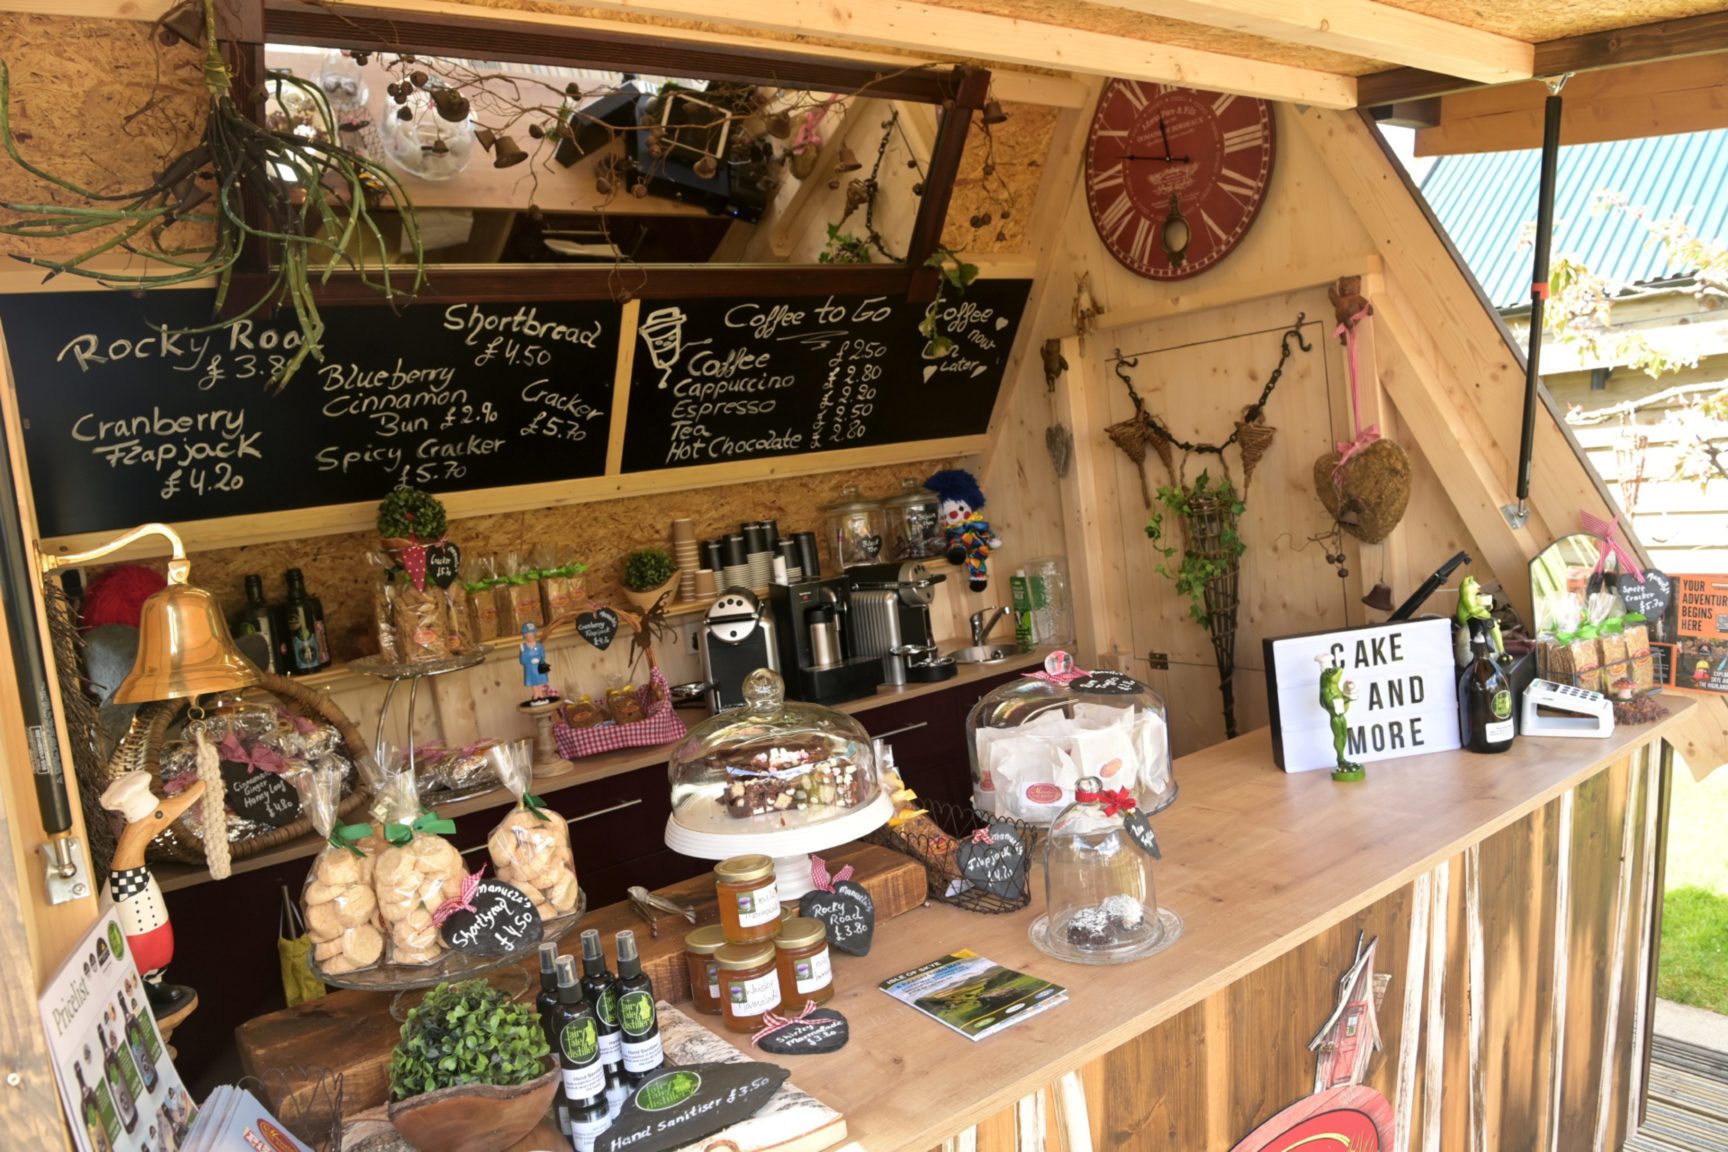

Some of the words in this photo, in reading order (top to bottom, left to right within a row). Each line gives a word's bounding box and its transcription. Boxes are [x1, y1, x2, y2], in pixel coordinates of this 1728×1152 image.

[443, 303, 601, 348] Shortbread
[724, 303, 806, 338] Coffee
[814, 295, 846, 325] to
[851, 296, 891, 322] Go
[925, 298, 993, 332] Coffee
[57, 324, 210, 371] Rocky
[223, 319, 322, 351] Roa
[475, 336, 551, 367] £4.50
[198, 354, 294, 390] £3.8
[318, 358, 455, 392] Blueberry
[688, 347, 770, 378] Coffee
[322, 388, 467, 417] Cinnamon
[521, 379, 604, 421] Cracker
[673, 373, 795, 400] Cappuccino
[71, 406, 245, 440] Cranberry
[369, 411, 428, 437] Bun
[520, 411, 586, 441] £5.70
[671, 400, 776, 422] Espresso
[665, 440, 706, 465] Hot
[708, 428, 801, 458] Chocolate
[670, 421, 712, 442] Tea
[315, 445, 402, 473] Spicy
[416, 434, 506, 459] Cracker
[1683, 579, 1705, 592] YOUR
[1681, 606, 1713, 619] BEGINS
[1681, 619, 1703, 632] HERE
[1330, 633, 1404, 669] CAKE
[1369, 675, 1425, 711] AND
[1347, 717, 1425, 756] MORE
[812, 901, 845, 918] Rocky
[830, 905, 864, 925] Road
[51, 977, 90, 1037] Pricelist
[610, 1125, 652, 1152] Hand
[656, 1097, 722, 1132] Sanitiser
